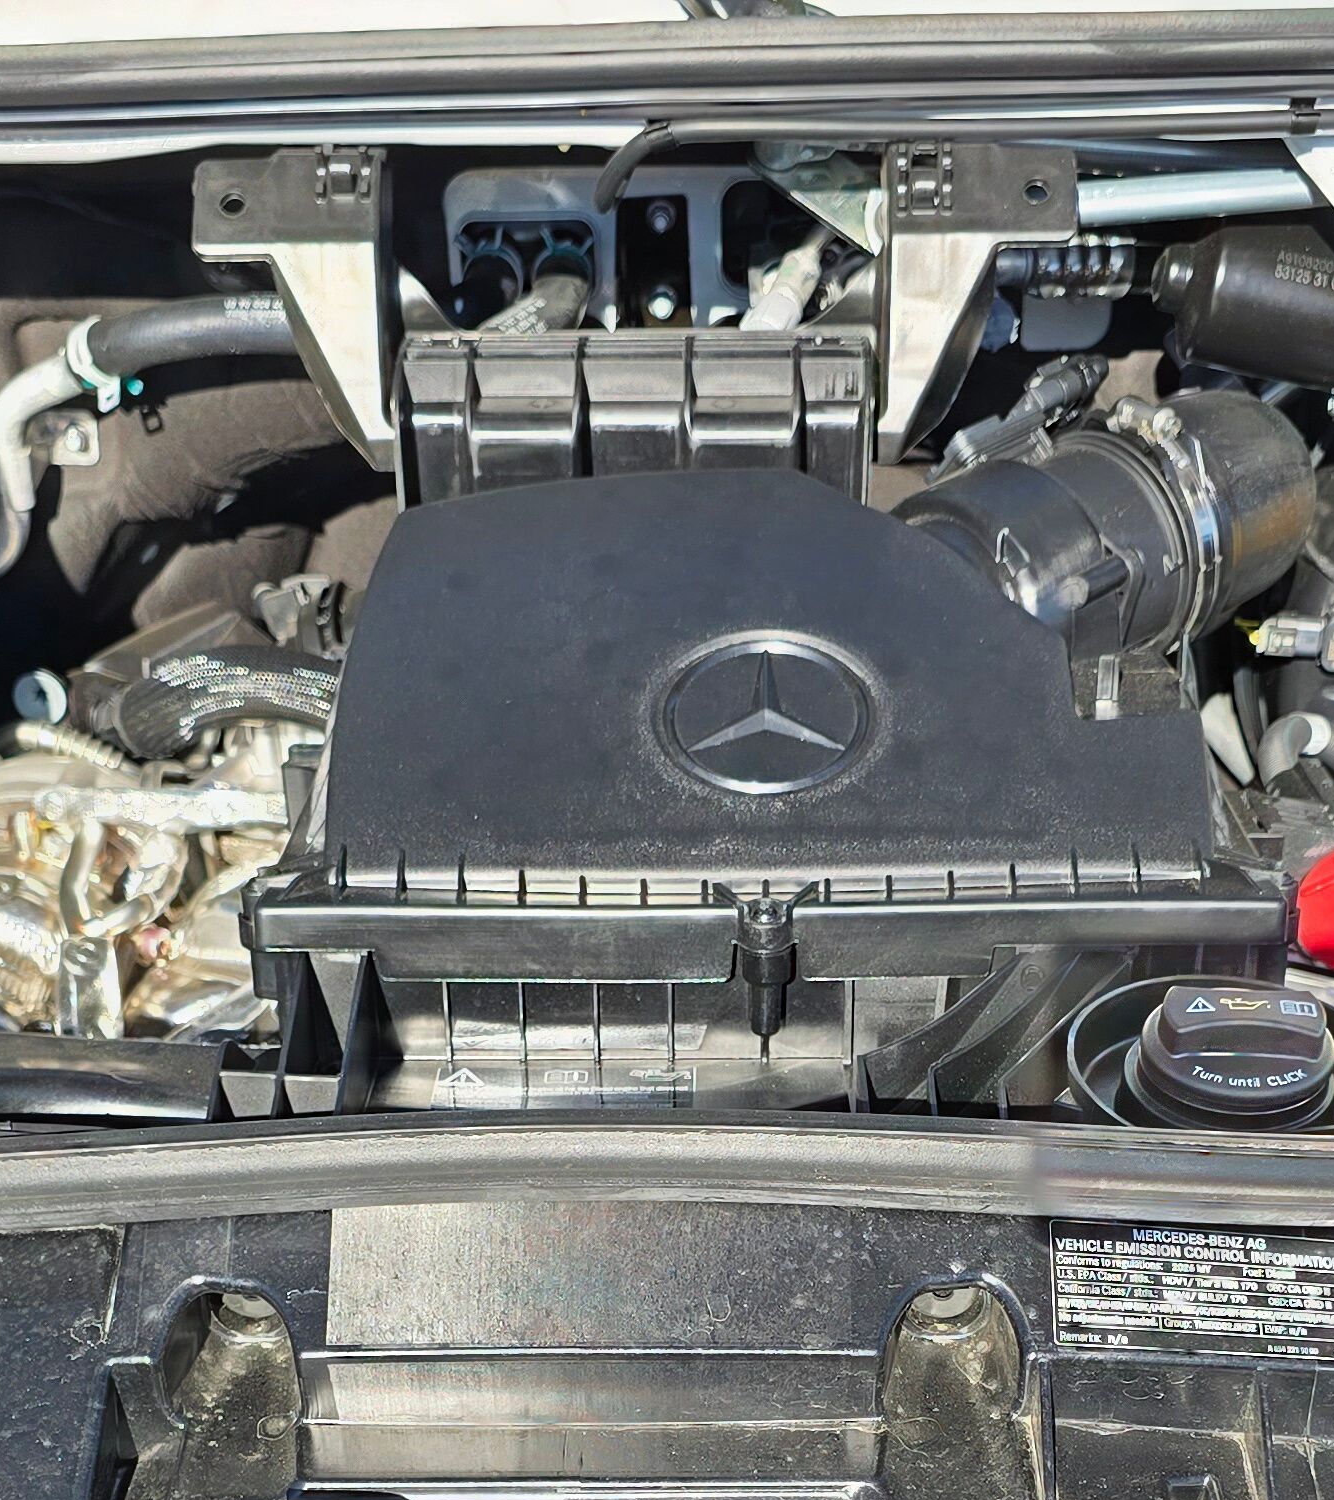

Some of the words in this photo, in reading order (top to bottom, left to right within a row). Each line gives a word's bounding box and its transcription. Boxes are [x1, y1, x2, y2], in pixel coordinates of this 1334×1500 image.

[1192, 1065, 1222, 1084] Turn
[1228, 1077, 1261, 1088] until
[1266, 1068, 1308, 1087] CLICK
[1132, 1228, 1244, 1249] MERCEDES-BENZ
[1244, 1236, 1266, 1250] AG
[1055, 1237, 1113, 1253] VEHICLE
[1115, 1241, 1181, 1258] EMISSION
[1182, 1246, 1248, 1263] CONTROL
[1055, 1254, 1099, 1266] Conforms
[1111, 1258, 1163, 1271] regulations:
[1056, 1268, 1076, 1279] U.S.
[1077, 1270, 1096, 1280] EPA
[1056, 1283, 1100, 1295] California
[1240, 1280, 1258, 1291] 170
[1229, 1294, 1248, 1304] 170
[1164, 1318, 1193, 1329] Group:
[1059, 1331, 1102, 1343] Remarks:
